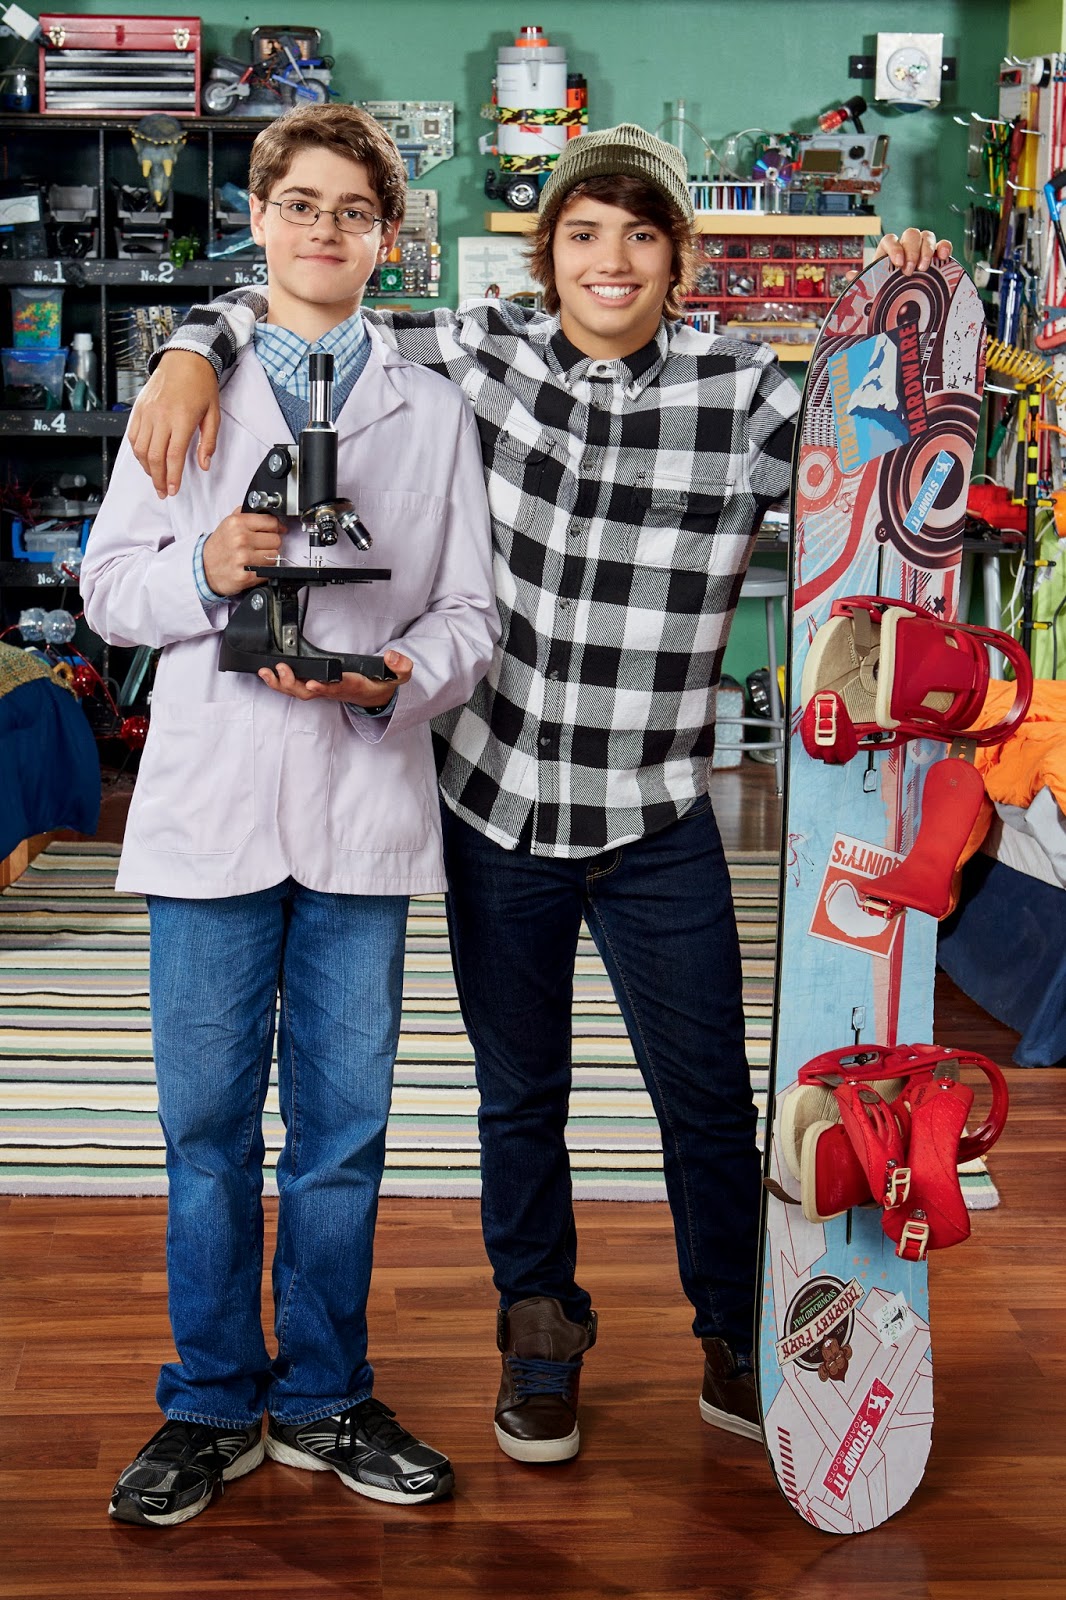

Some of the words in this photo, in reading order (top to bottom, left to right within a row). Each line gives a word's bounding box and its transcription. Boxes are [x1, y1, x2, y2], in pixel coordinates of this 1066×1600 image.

[33, 261, 66, 283] No.1
[139, 262, 174, 284] No.2
[234, 264, 268, 285] No.3
[899, 323, 928, 437] HARDWARE
[33, 412, 67, 433] No.4
[917, 480, 940, 518] STOMP
[911, 516, 921, 531] IT
[805, 1288, 838, 1322] SNOWBOARD
[792, 1313, 806, 1330] WAX
[844, 1415, 863, 1448] BOARD
[842, 1420, 874, 1476] STOMP
[827, 1450, 846, 1484] BOOTS
[833, 1472, 849, 1495] IT
